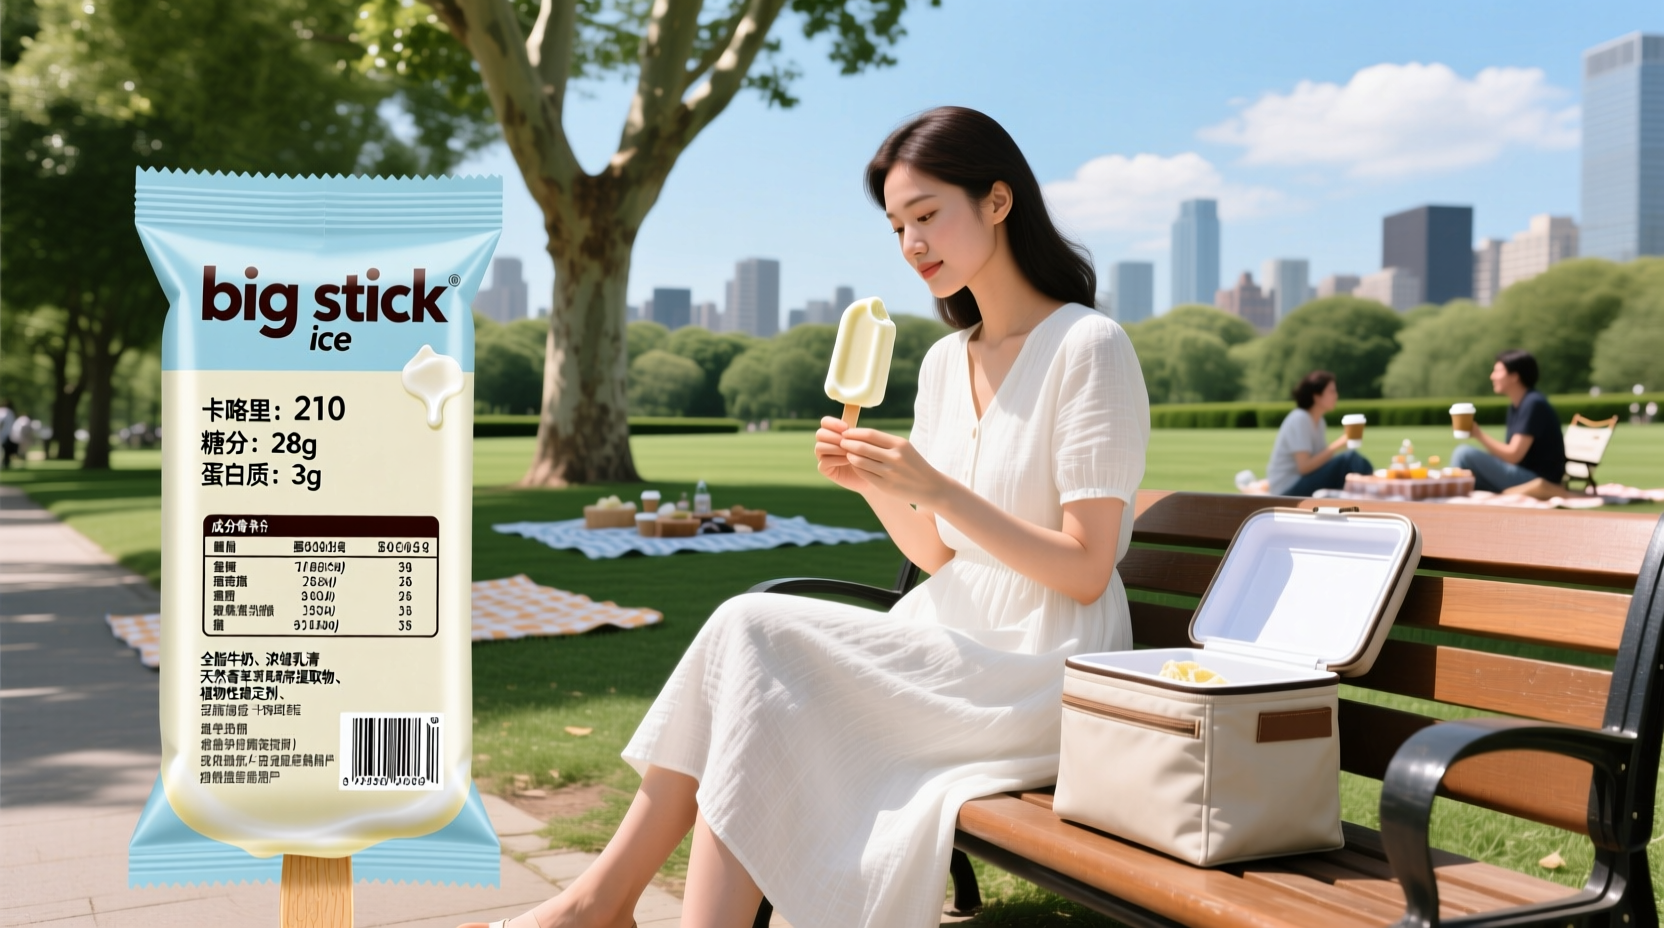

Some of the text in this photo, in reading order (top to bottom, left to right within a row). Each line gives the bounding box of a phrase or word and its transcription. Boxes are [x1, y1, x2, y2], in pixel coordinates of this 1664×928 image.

[201, 265, 449, 339] big stick
[309, 324, 352, 352] ice
[294, 395, 346, 421] 210
[271, 431, 317, 461] 28g
[291, 463, 322, 492] 3g
